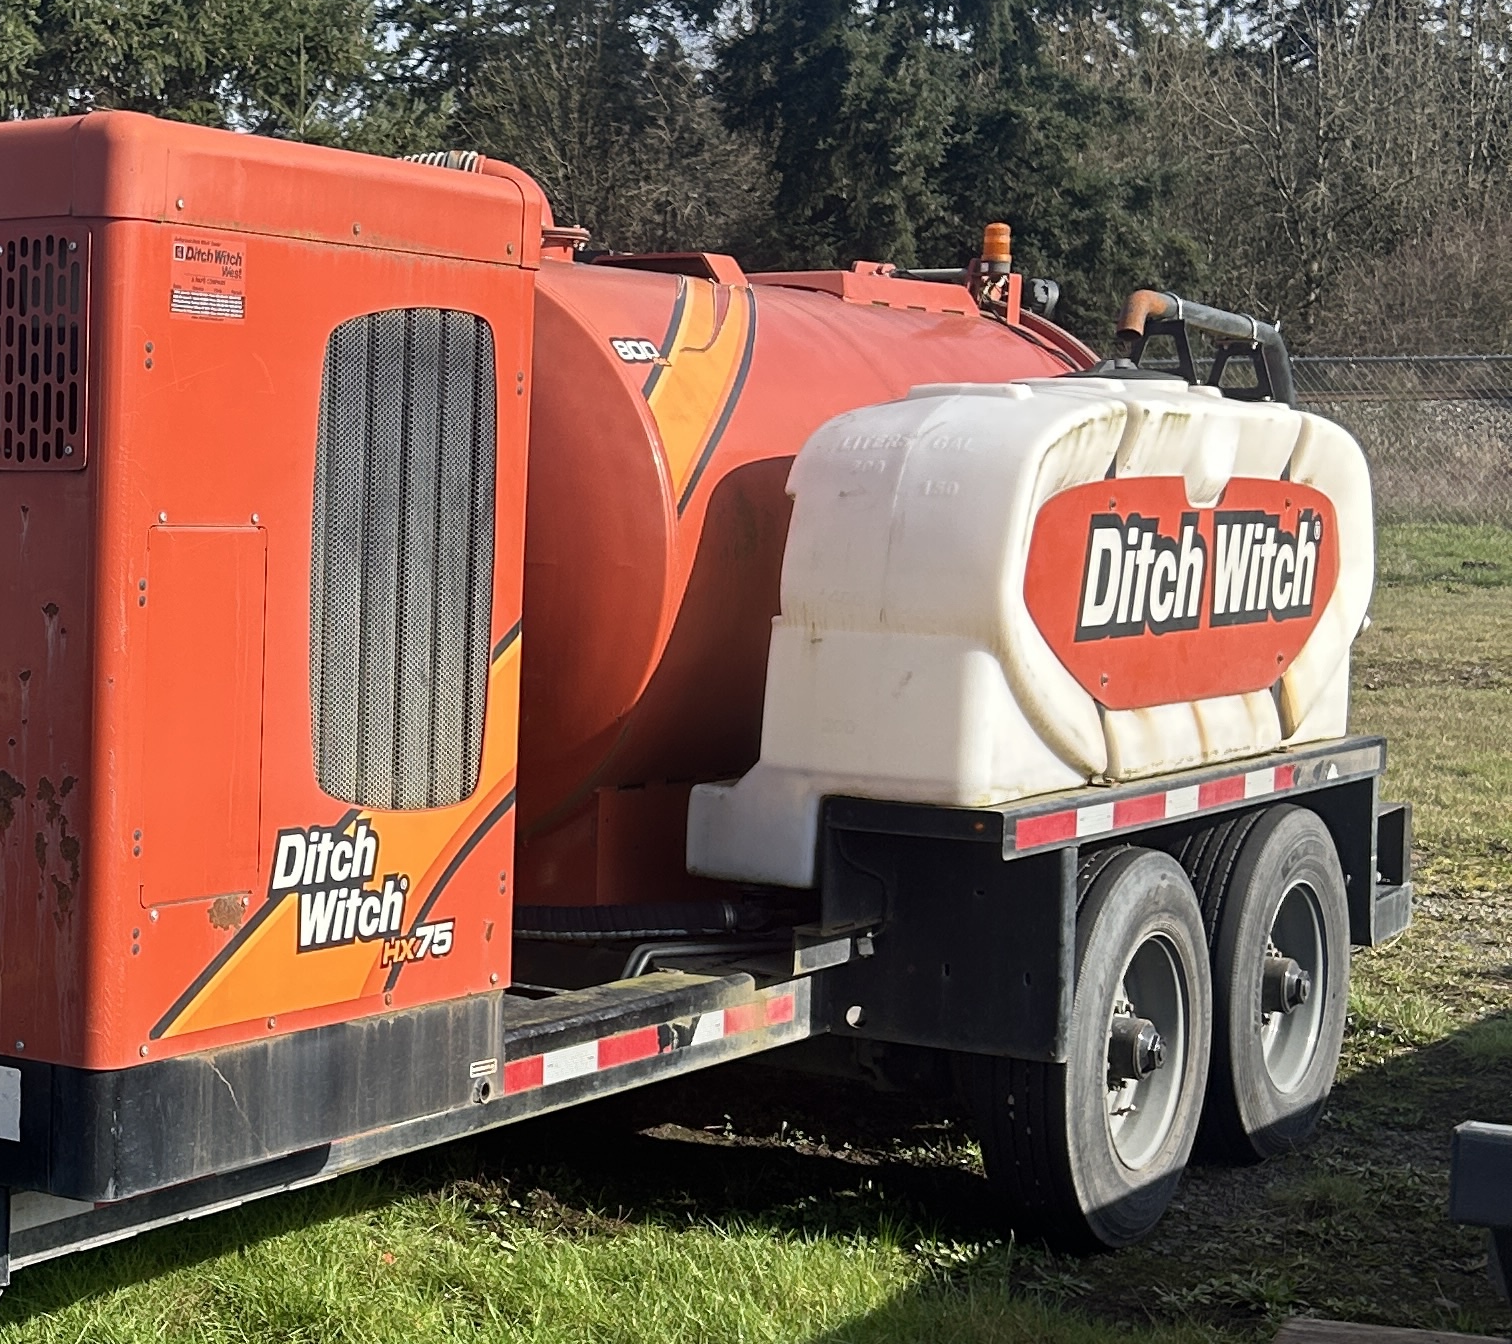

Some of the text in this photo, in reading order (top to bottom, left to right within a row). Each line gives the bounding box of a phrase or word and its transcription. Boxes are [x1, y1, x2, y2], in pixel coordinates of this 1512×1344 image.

[185, 246, 242, 267] Ditch Witch
[222, 266, 242, 279] West
[612, 340, 660, 360] 800
[1081, 521, 1317, 627] Ditch Witch
[272, 824, 377, 890] Ditch
[300, 880, 404, 947] Witch
